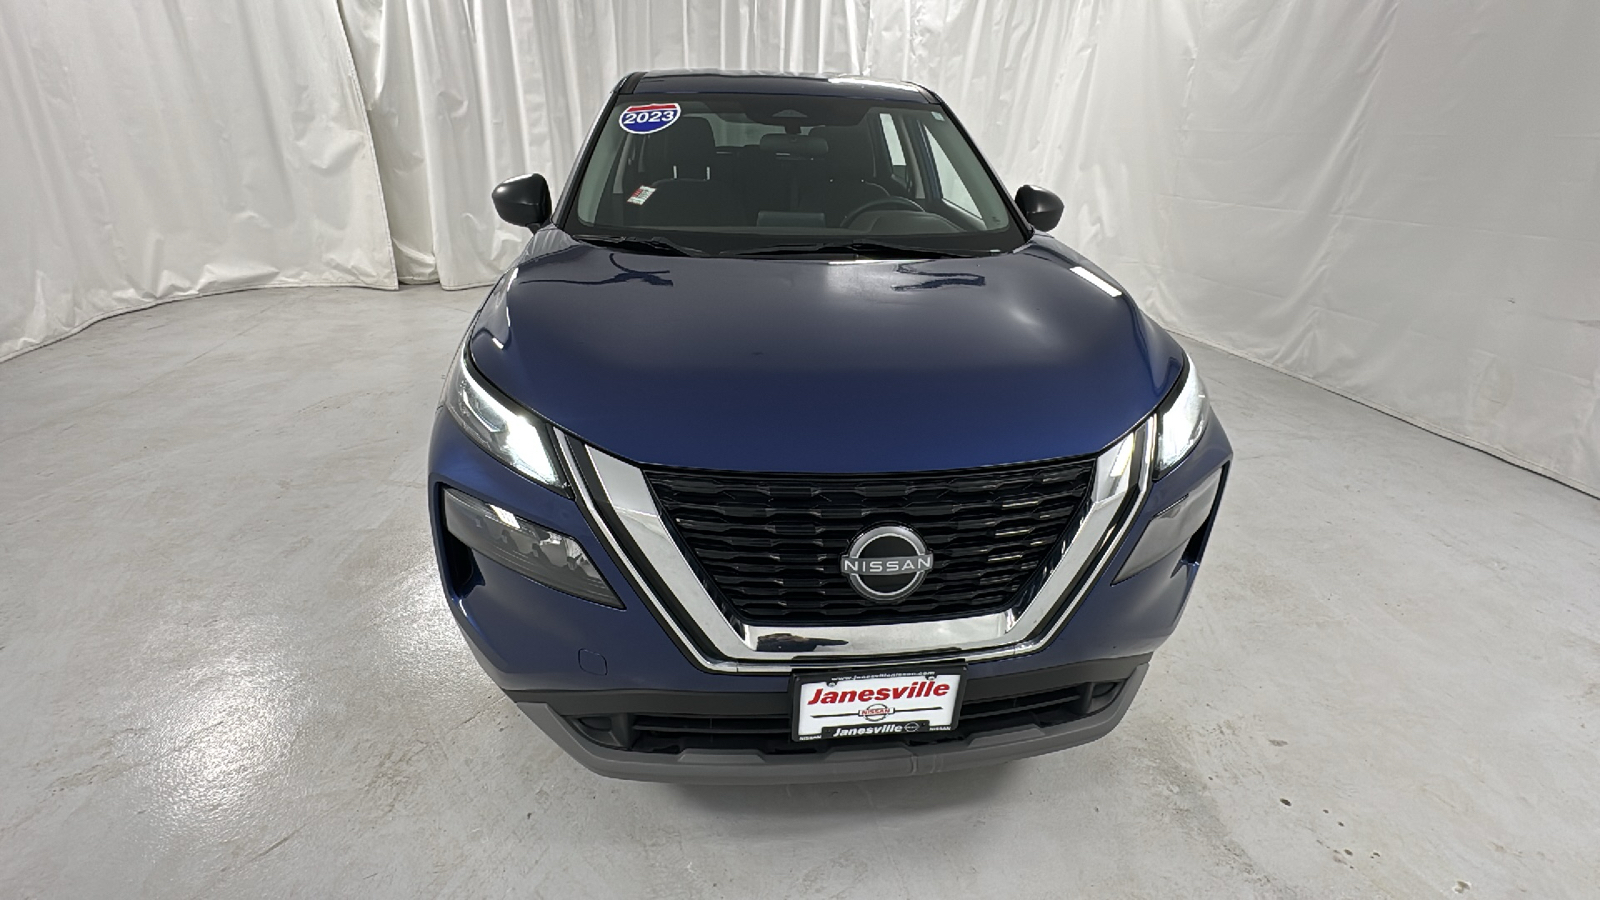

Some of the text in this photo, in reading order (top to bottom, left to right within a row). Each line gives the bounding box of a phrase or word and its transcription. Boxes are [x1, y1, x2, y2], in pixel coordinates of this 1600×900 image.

[623, 111, 675, 124] 2023
[844, 556, 930, 572] NISSAN
[807, 681, 950, 705] Janesville
[861, 708, 891, 716] NISSAN
[833, 724, 903, 737] Janesville
